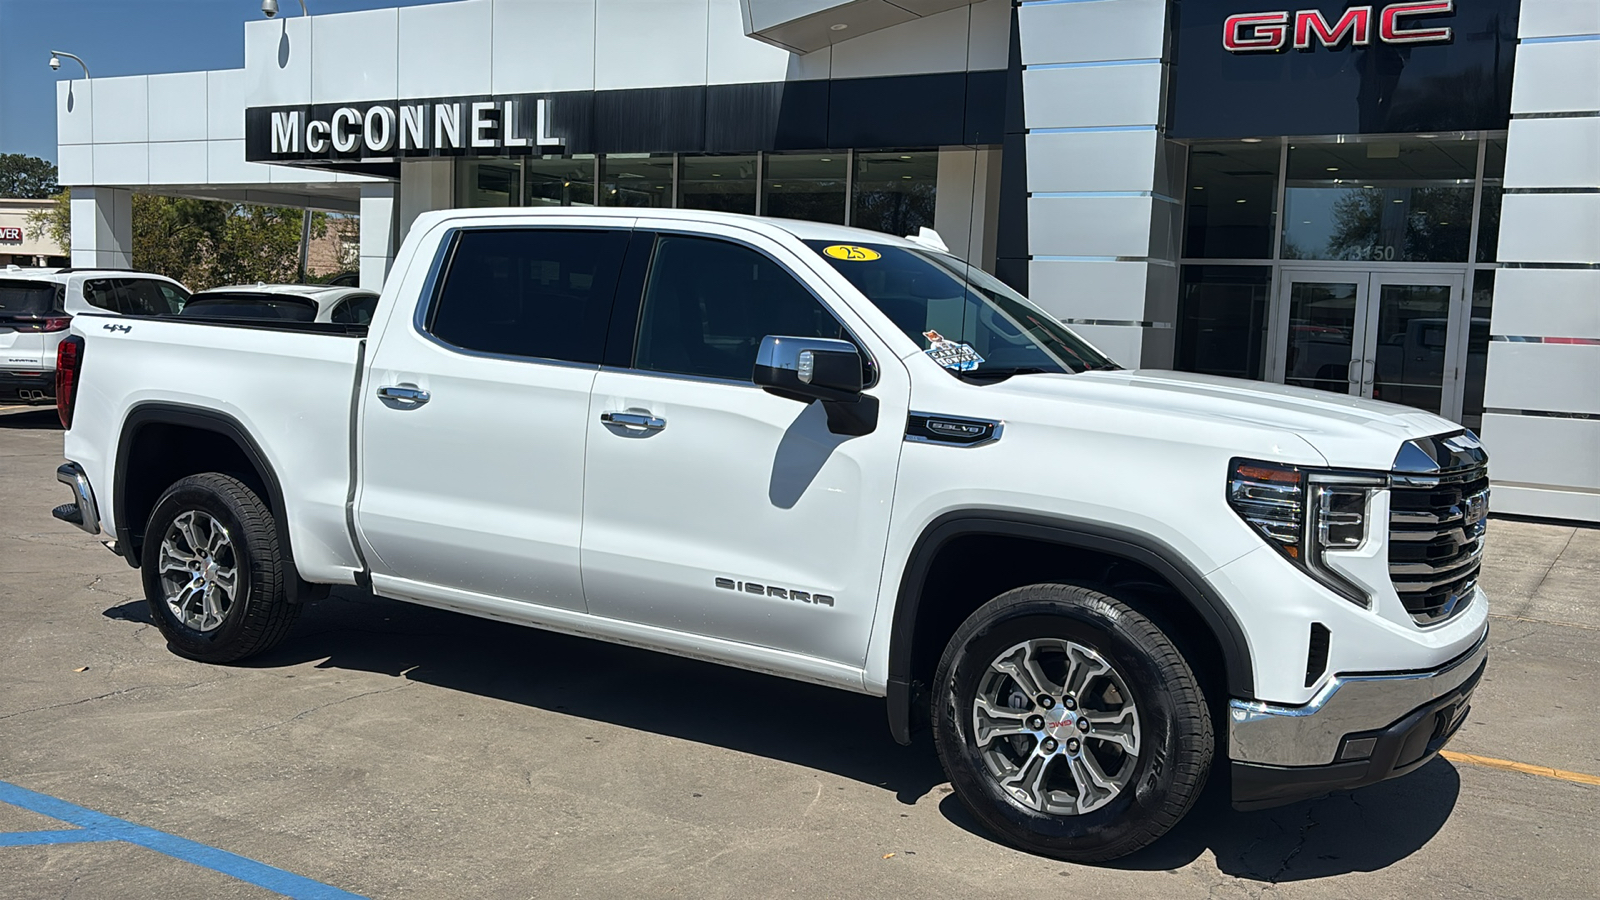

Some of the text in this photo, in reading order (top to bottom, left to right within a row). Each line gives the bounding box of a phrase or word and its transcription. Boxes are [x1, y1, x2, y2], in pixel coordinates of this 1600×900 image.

[1223, 0, 1453, 52] GMC
[271, 98, 563, 154] McCONNELL
[840, 246, 866, 260] 25
[1350, 245, 1395, 261] 3150
[715, 577, 835, 607] SIERRA
[1048, 719, 1072, 729] GMC
